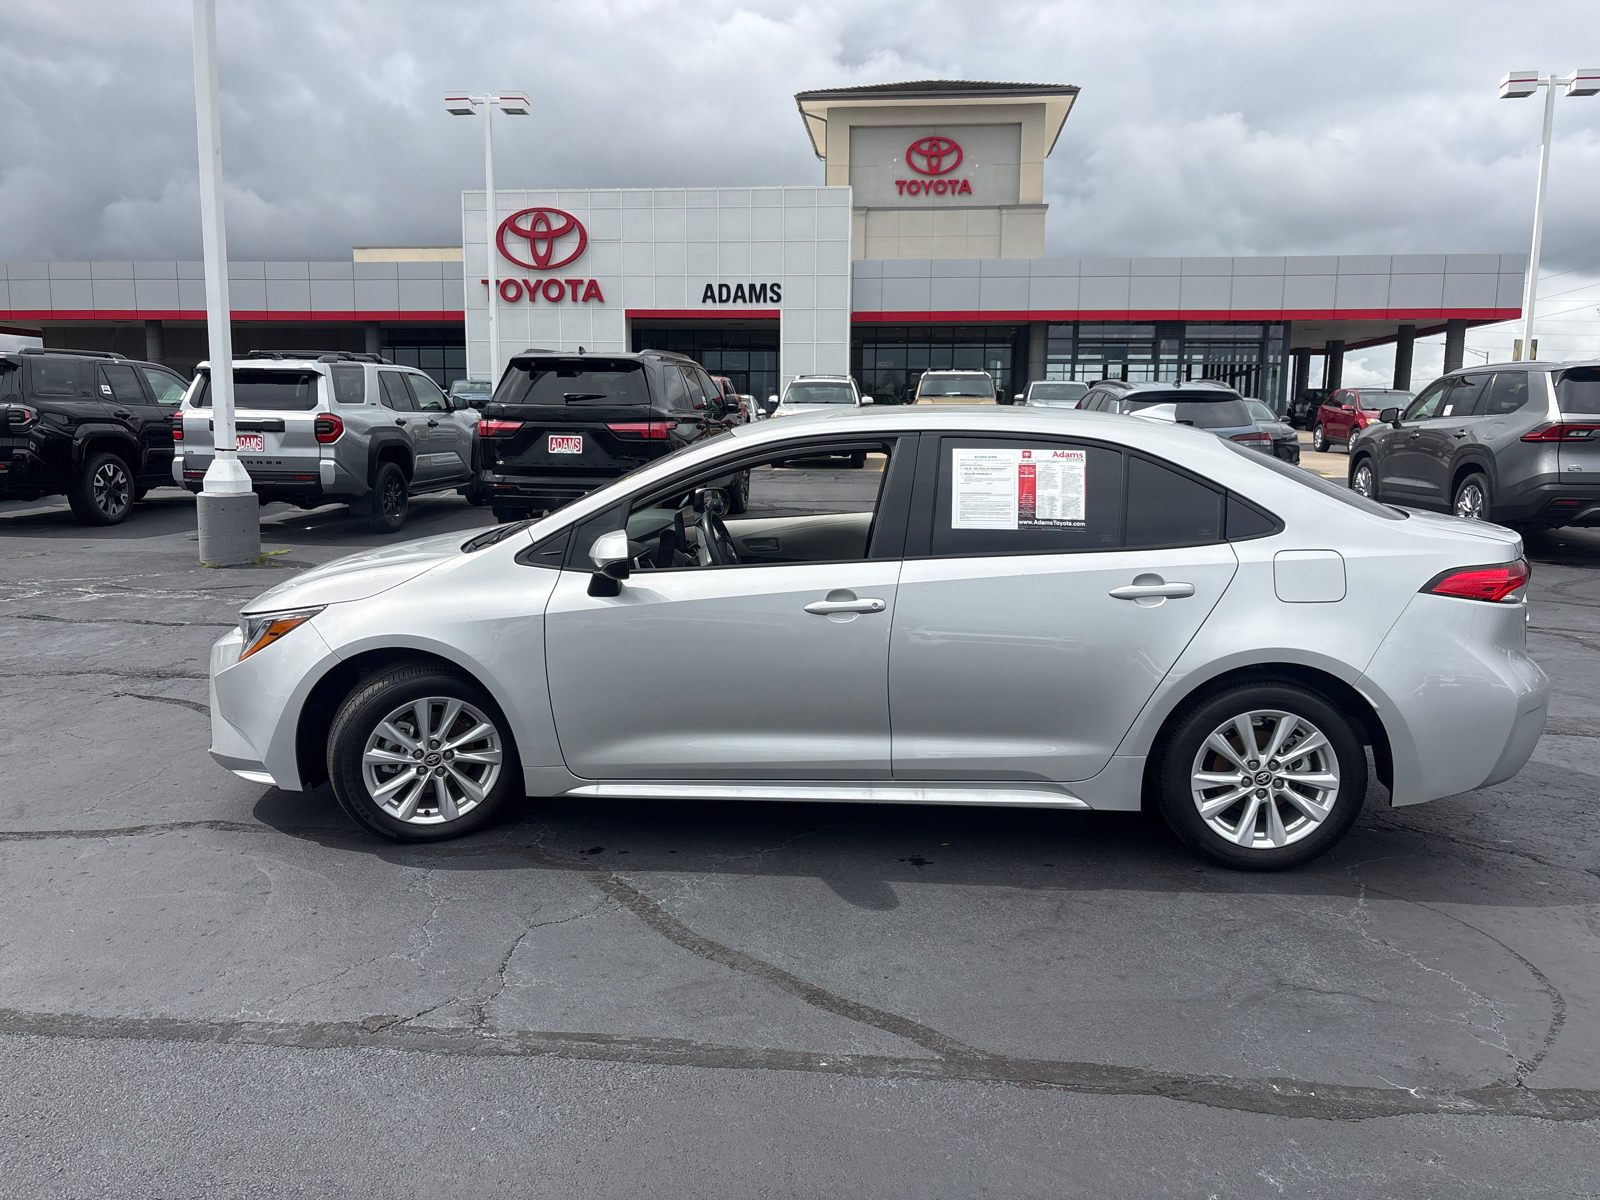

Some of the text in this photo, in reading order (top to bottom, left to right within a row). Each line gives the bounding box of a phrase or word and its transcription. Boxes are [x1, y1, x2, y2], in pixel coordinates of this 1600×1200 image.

[895, 179, 972, 195] TOYOTA
[702, 283, 782, 304] ADAMS
[236, 437, 262, 449] ADAMS
[551, 438, 580, 450] ADAMS
